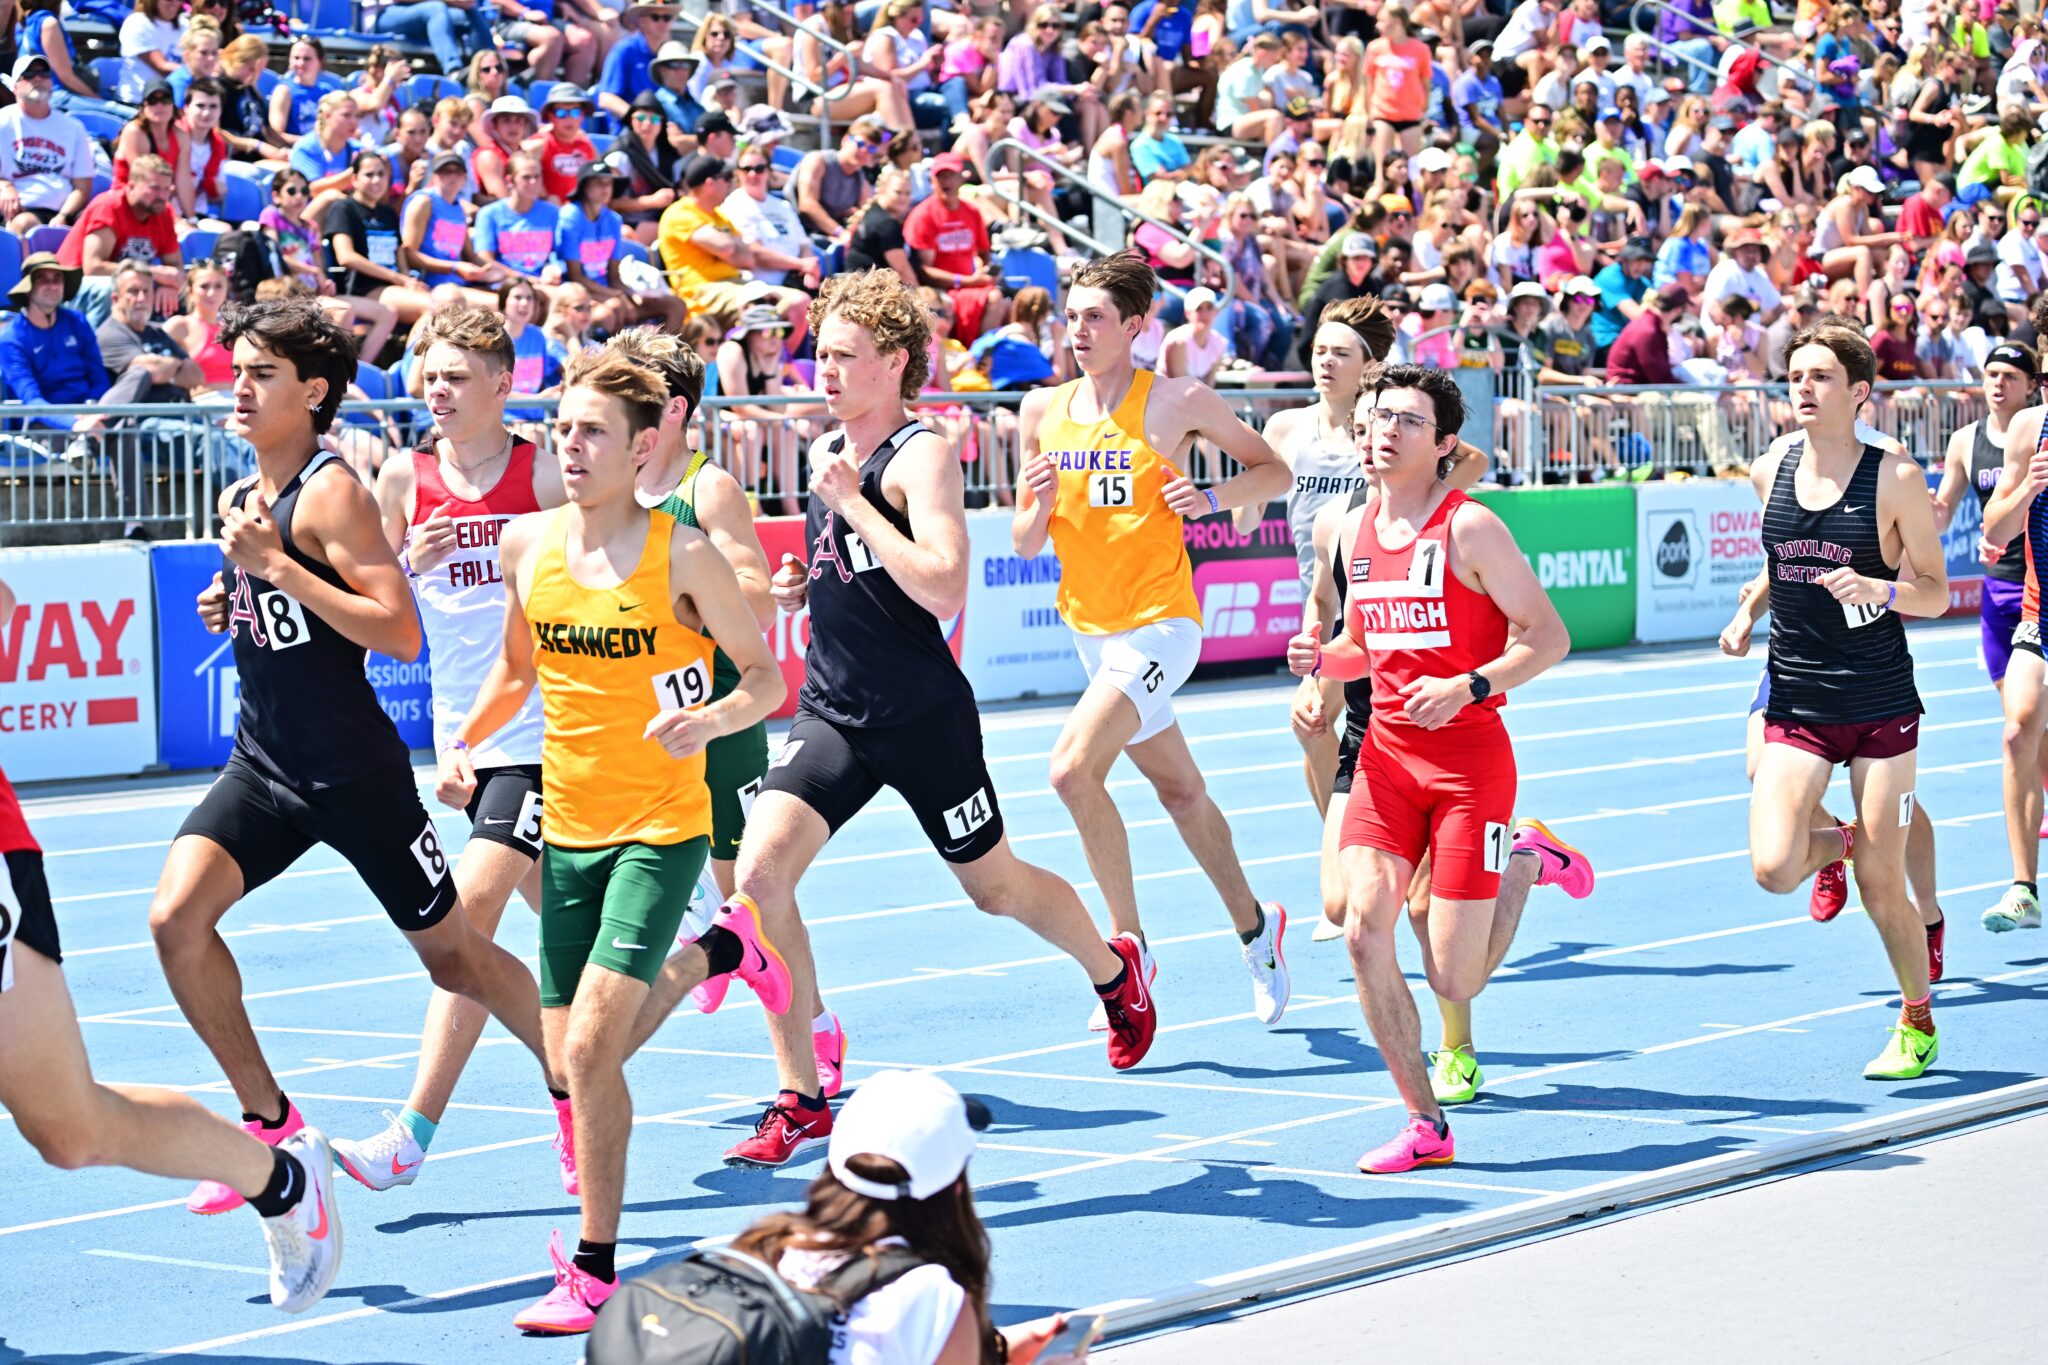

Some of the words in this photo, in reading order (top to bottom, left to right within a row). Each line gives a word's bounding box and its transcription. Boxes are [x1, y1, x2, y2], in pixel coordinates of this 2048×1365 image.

[1098, 477, 1126, 505] 15
[1711, 512, 1761, 533] IOWA
[1423, 544, 1437, 586] 1
[1711, 537, 1763, 559] PORK
[1775, 540, 1852, 564] DOWLING
[449, 560, 503, 587] FALL
[1539, 550, 1627, 589] DENTAL
[1777, 563, 1833, 584] CATH
[268, 594, 299, 644] 8
[1388, 602, 1447, 629] HIGH
[536, 622, 657, 659] KENNEDY
[665, 666, 705, 708] 19
[1142, 661, 1164, 694] 15
[954, 795, 987, 833] 14
[420, 830, 445, 875] 8
[1491, 826, 1501, 870] 1
